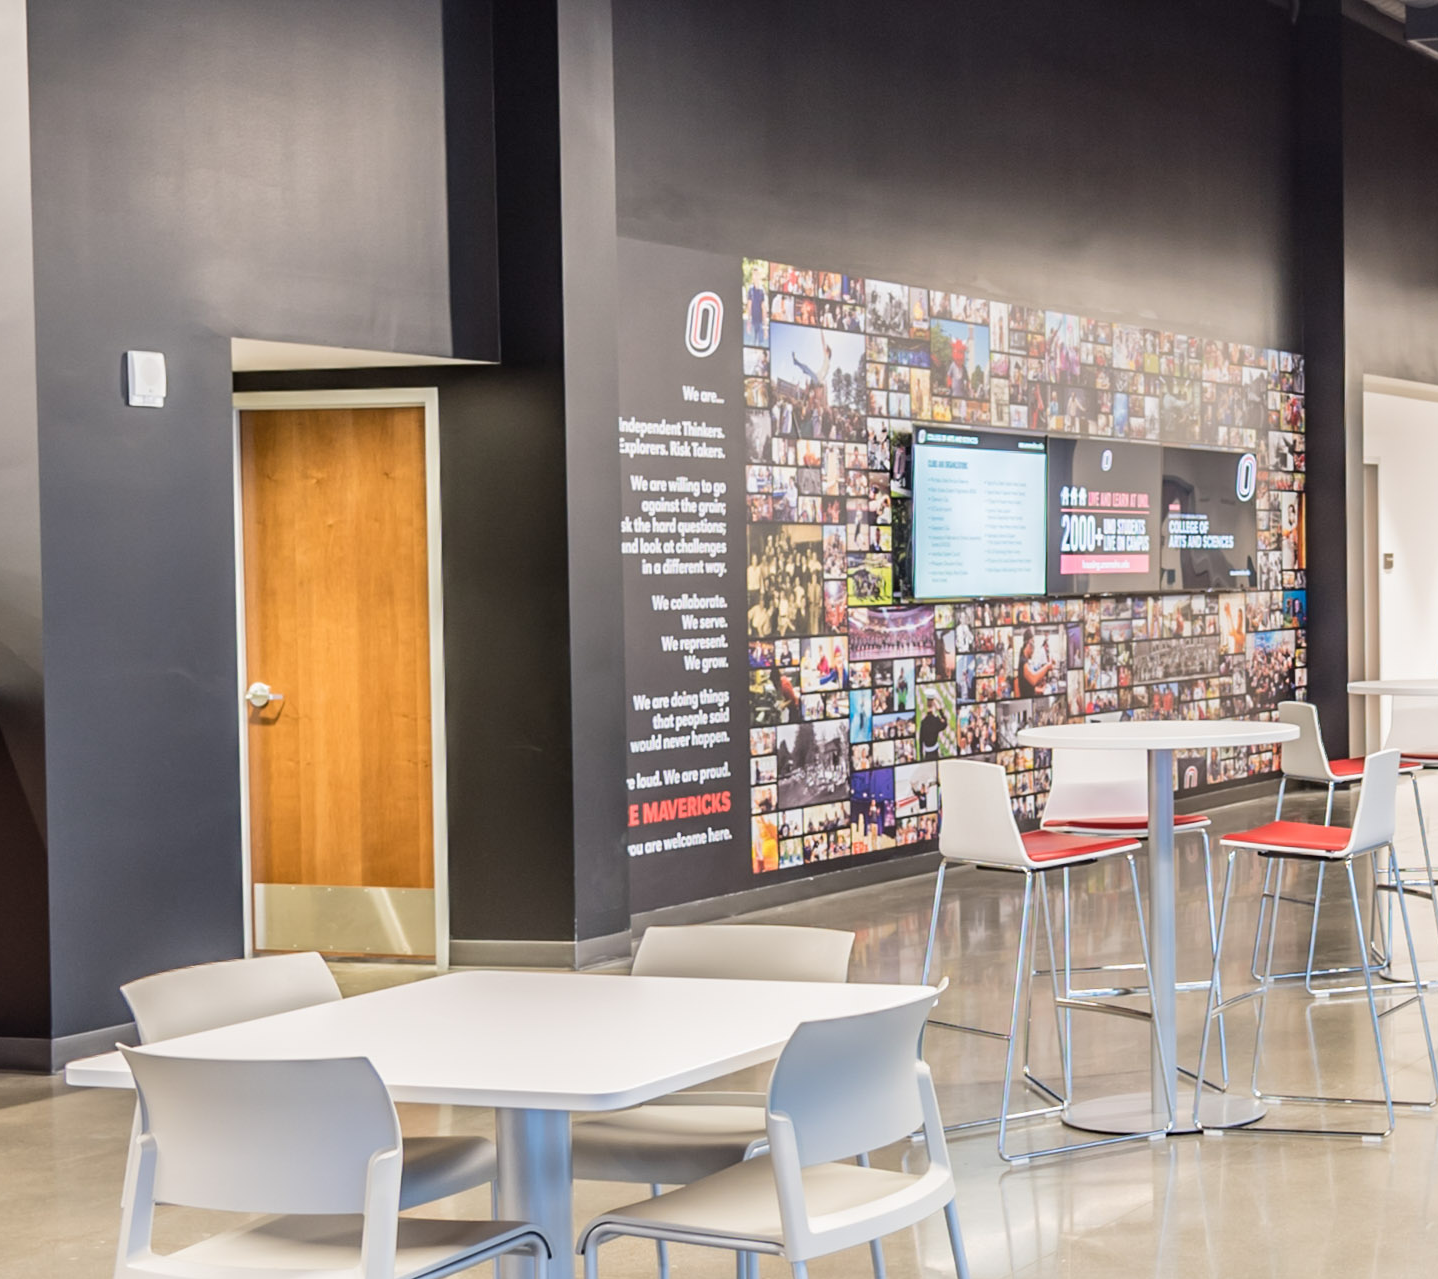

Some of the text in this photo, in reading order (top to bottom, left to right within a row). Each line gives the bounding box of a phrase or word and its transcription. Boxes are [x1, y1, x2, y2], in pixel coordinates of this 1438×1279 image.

[682, 385, 699, 402] We
[618, 416, 725, 439] Independent Thinkers.
[669, 440, 691, 457] Risk
[691, 442, 726, 459] Takers.
[630, 475, 726, 497] We are willing to go
[641, 497, 680, 516] against
[681, 497, 697, 513] the
[620, 516, 633, 533] sk
[633, 517, 651, 533] the
[652, 517, 676, 533] hard
[1060, 514, 1104, 552] 2000+
[1117, 519, 1146, 535] STUDENTS
[1168, 520, 1210, 534] COLLEGE OF
[640, 537, 662, 554] look
[663, 540, 675, 554] at
[675, 538, 727, 558] challenges
[1126, 536, 1150, 552] CAMPUS
[1168, 535, 1234, 549] ARTS AND SCIENCES
[641, 558, 727, 577] in a different way.
[651, 593, 728, 611] We collaborate.
[681, 614, 728, 630] We serve.
[661, 634, 728, 654] We represent.
[683, 655, 729, 673] We grow.
[633, 689, 730, 711] We are doing things
[652, 707, 730, 731] that people said
[630, 730, 730, 753] would never happen.
[636, 770, 663, 789] loud.
[663, 769, 680, 786] We
[681, 770, 698, 783] are
[699, 761, 731, 785] proud.
[642, 790, 732, 824] MAVERICKS
[644, 839, 662, 854] are
[663, 832, 707, 851] welcome
[707, 826, 732, 844] here.
